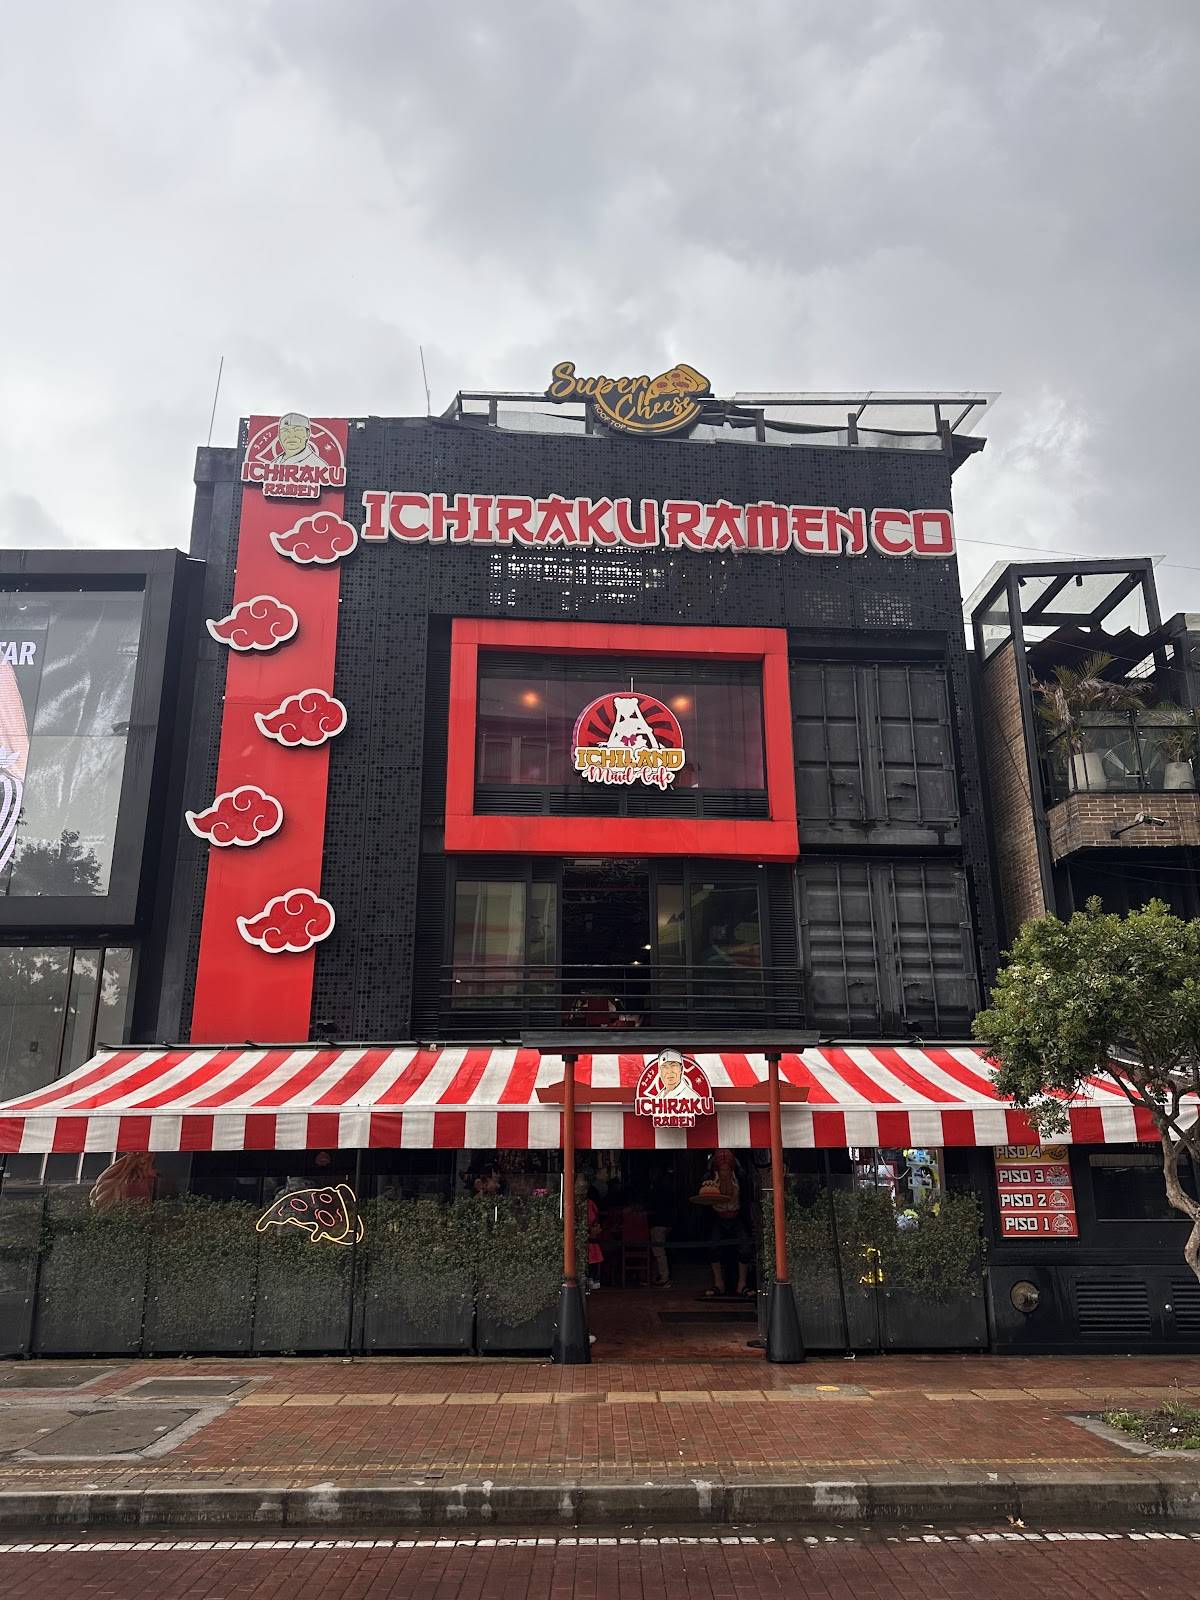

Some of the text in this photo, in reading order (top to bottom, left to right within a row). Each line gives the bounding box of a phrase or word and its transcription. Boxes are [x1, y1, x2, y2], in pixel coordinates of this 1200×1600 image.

[551, 361, 650, 397] Super
[614, 390, 694, 421] Cheese
[241, 462, 345, 486] ICHIRAKU
[264, 483, 319, 497] RAMEN
[362, 492, 954, 554] ICHIRAKU RAMEN CO
[576, 748, 683, 769] ICHILAND
[635, 1098, 714, 1115] ICHIRAKU
[653, 1115, 695, 1127] RAMEN
[995, 1146, 1040, 1159] PISO 4
[998, 1170, 1031, 1183] PISO
[1035, 1170, 1044, 1182] 3
[1000, 1194, 1034, 1207] PISO
[1038, 1194, 1047, 1206] 2
[1005, 1217, 1038, 1231] PISO
[1043, 1217, 1050, 1231] 1
